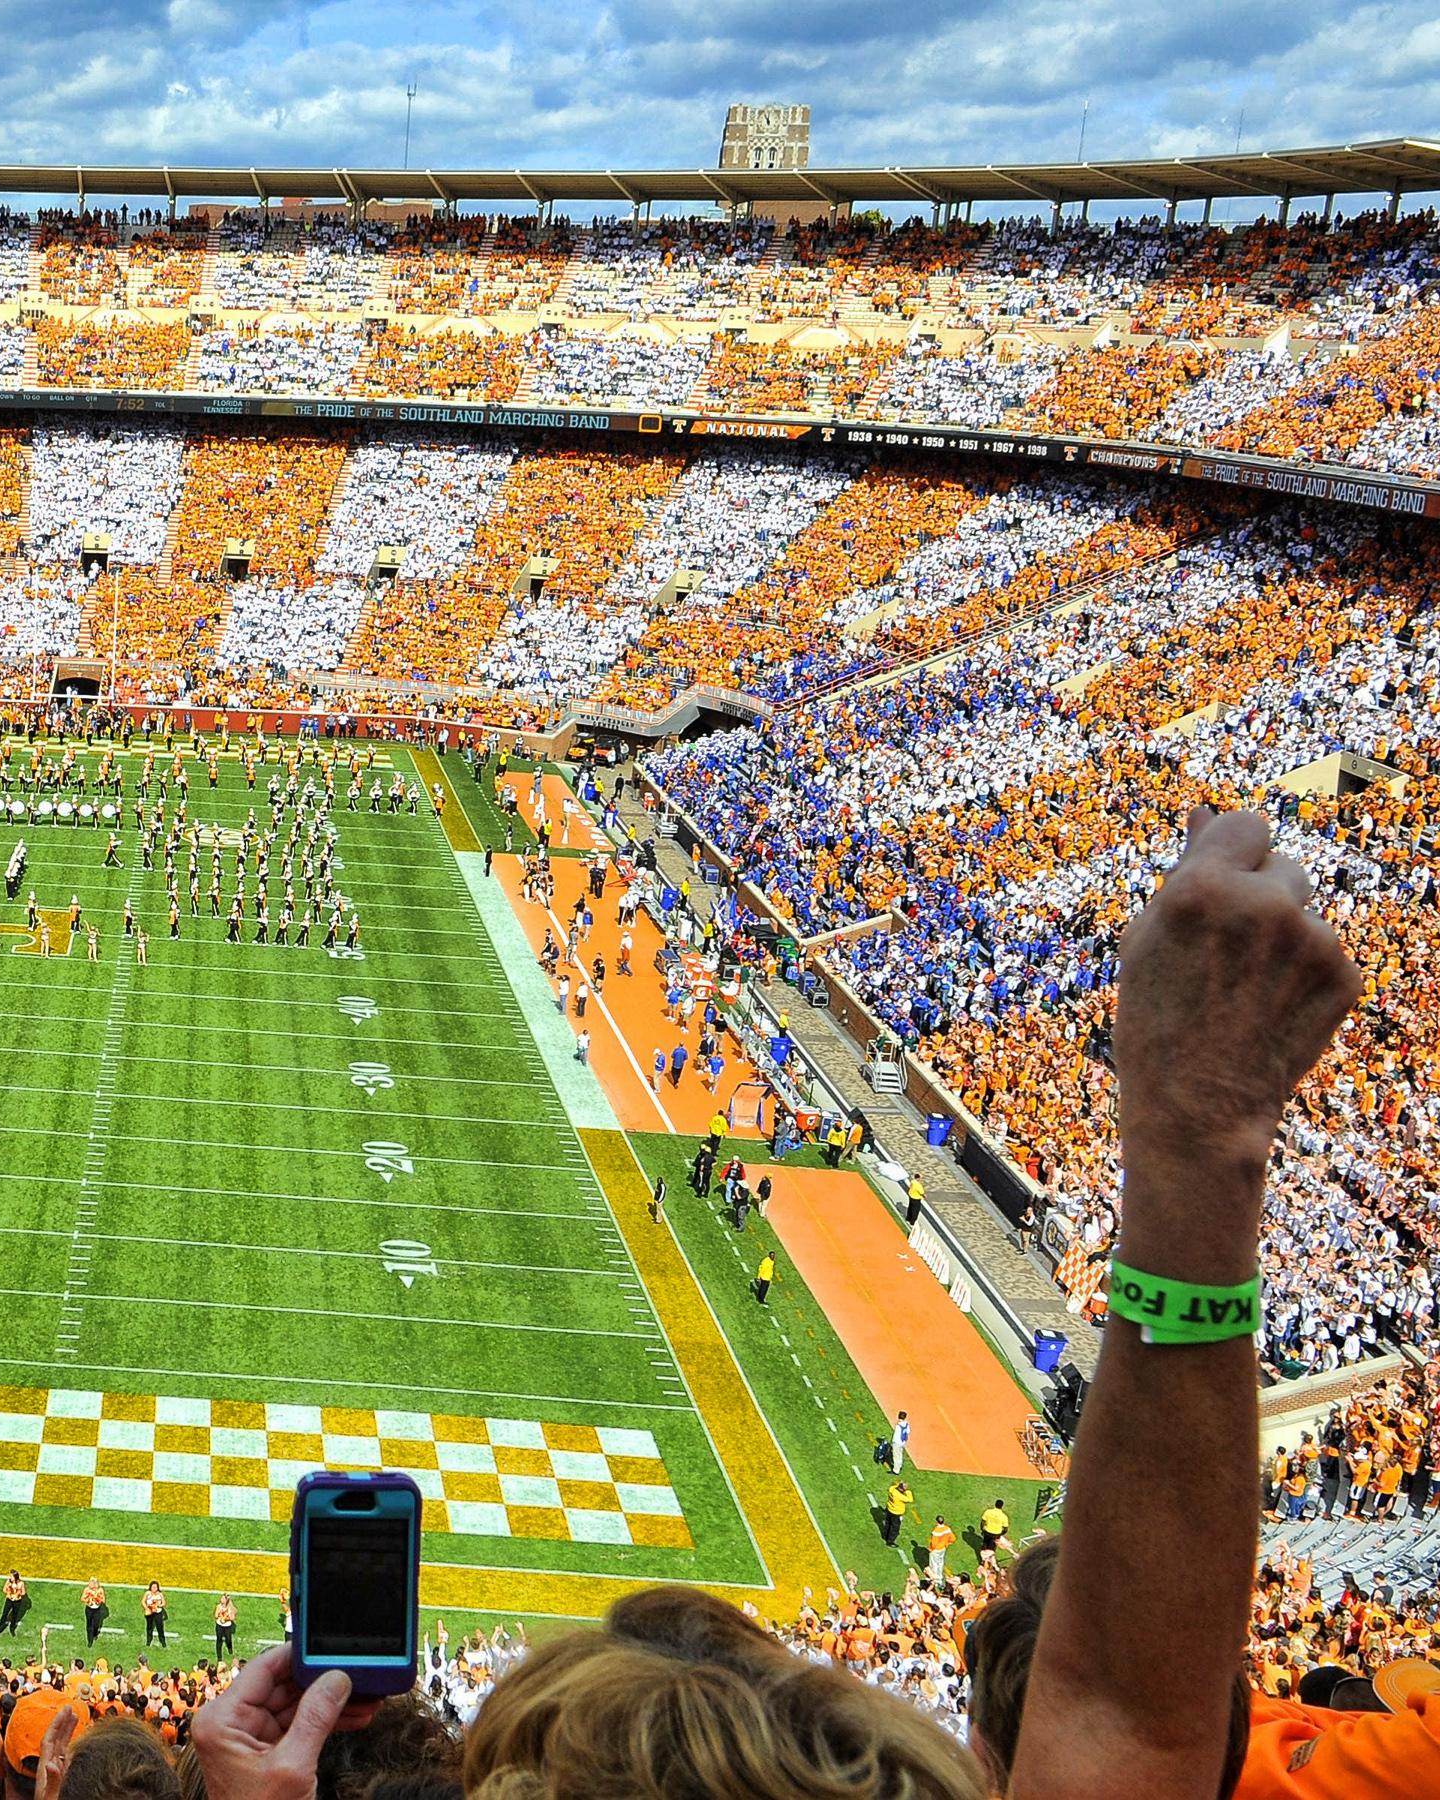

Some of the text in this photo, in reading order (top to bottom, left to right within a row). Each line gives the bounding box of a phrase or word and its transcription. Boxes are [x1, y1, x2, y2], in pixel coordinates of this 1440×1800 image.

[115, 399, 145, 410] 7:52
[203, 407, 243, 415] TENNESSEE
[294, 404, 610, 430] THE PRIDE OF THE SOUTHLAND MARCHING BAND
[672, 420, 687, 434] T
[706, 423, 789, 438] NATIONAL
[821, 427, 835, 442] T
[848, 431, 1048, 456] 1938 1940 1950 1951 1967 1998
[1064, 446, 1078, 462] T
[1090, 449, 1158, 470] CHAMPIONS
[1214, 464, 1240, 484] PRIDE
[1242, 470, 1251, 484] OF
[1252, 471, 1264, 486] THE
[1266, 471, 1326, 498] SOUTHLAND
[1328, 481, 1389, 508] MARCHING
[1391, 489, 1426, 515] BAND
[336, 995, 379, 1020] 40
[348, 1061, 396, 1090] 30
[361, 1140, 414, 1175] 20
[378, 1238, 440, 1277] 10
[1179, 1296, 1253, 1324] KAT
